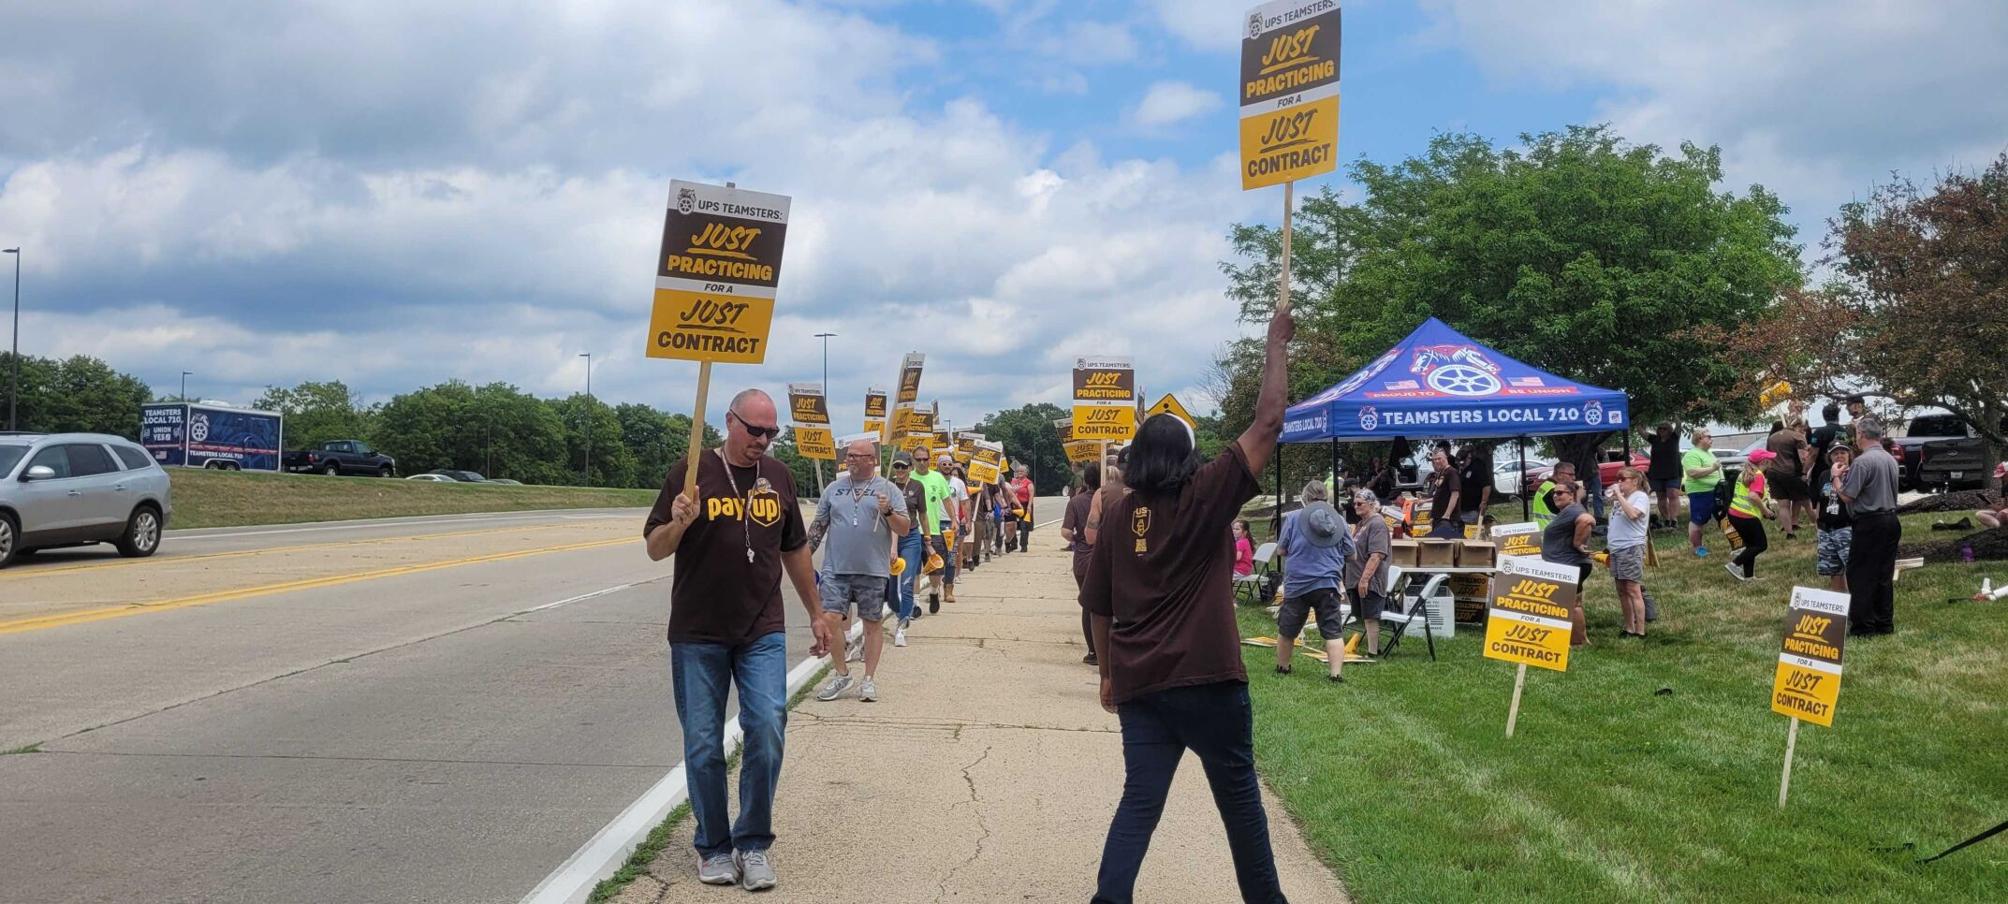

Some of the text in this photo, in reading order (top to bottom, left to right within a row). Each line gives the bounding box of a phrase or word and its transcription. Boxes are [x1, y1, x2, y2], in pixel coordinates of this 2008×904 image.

[1265, 15, 1282, 28] UPS
[1262, 24, 1320, 66] JUST
[1246, 60, 1334, 98] PRACTICING
[1277, 94, 1302, 108] FOR A
[1261, 108, 1318, 145] JUST
[1248, 143, 1331, 178] CONTRACT
[698, 200, 783, 220] UPS TEAMSTERS:
[691, 222, 761, 250] JUST
[667, 254, 773, 281] PRACTICING
[704, 284, 733, 294] FOR A
[680, 299, 749, 325] JUST
[658, 331, 759, 354] CONTRACT
[1086, 372, 1122, 385] JUST
[1076, 389, 1130, 398] PRACTICING
[144, 408, 182, 416] TEAMSTERS
[796, 398, 816, 409] JUST
[144, 416, 167, 424] LOCAL
[1086, 409, 1122, 421] JUST
[1383, 408, 1580, 425] TEAMSTERS LOCAL 710
[803, 431, 822, 440] JUST
[1078, 426, 1130, 435] CONTRACT
[190, 450, 218, 458] TEAMSTERS
[835, 488, 876, 496] STEEL
[708, 497, 778, 522] pay up
[1136, 506, 1148, 514] US
[1504, 535, 1530, 546] JUST
[1516, 566, 1575, 582] UPS TEAMSTERS:
[1512, 579, 1559, 598] JUST
[1496, 596, 1568, 618] PRACTICING
[1800, 600, 1845, 613] UPS TEAMSTERS:
[1505, 624, 1552, 643] JUST
[1795, 614, 1832, 636] JUST
[1492, 642, 1562, 664] CONTRACT
[1784, 638, 1838, 660] PRACTICING
[1797, 658, 1808, 666] FOR
[1786, 670, 1823, 692] JUST
[1776, 692, 1828, 716] CONTRACT
